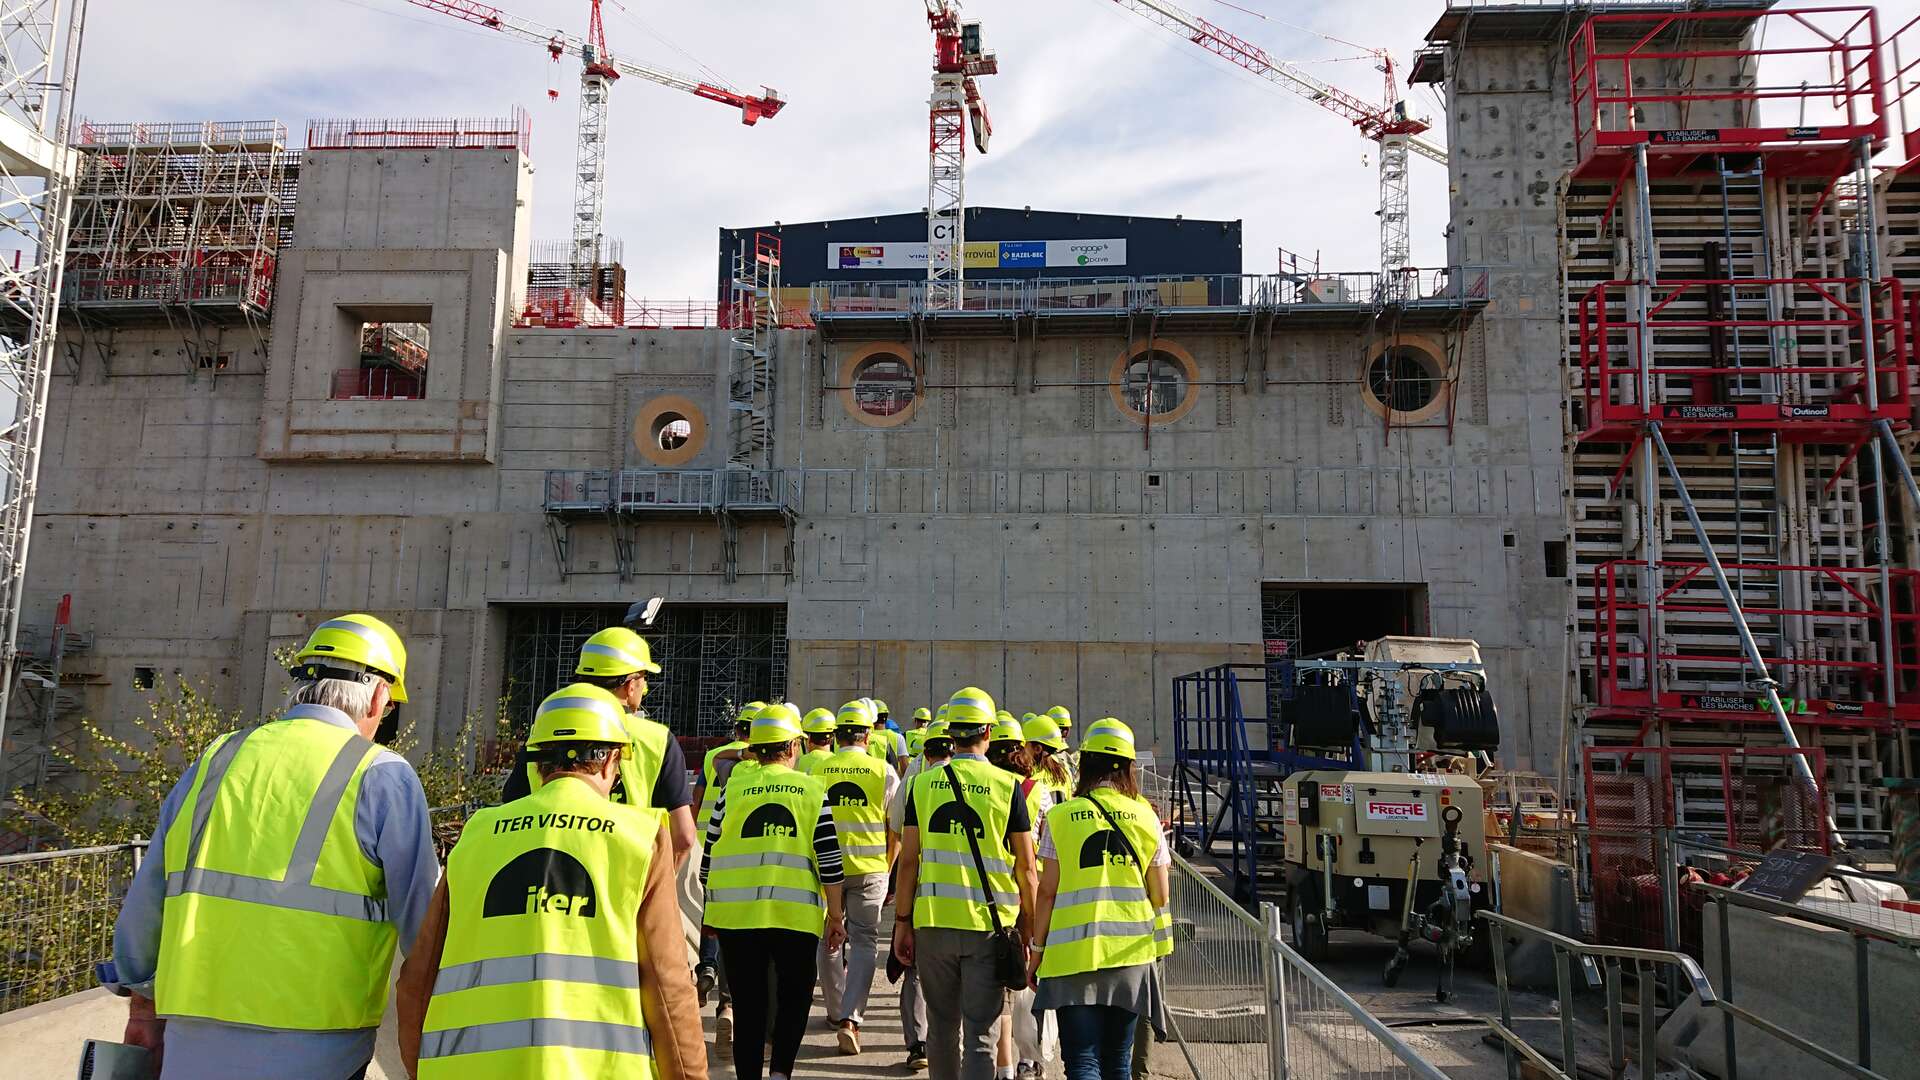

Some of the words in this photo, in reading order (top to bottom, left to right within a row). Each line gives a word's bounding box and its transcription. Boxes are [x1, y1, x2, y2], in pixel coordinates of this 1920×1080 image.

[934, 225, 955, 239] C1
[959, 249, 996, 259] rrovial
[840, 767, 871, 775] VISITOR
[743, 786, 763, 796] ITER
[765, 784, 804, 796] VISITOR
[931, 780, 951, 789] ITER
[952, 782, 991, 795] SITOR
[839, 795, 865, 807] iter
[1070, 810, 1094, 822] ITER
[1096, 810, 1137, 821] VITOR
[1369, 802, 1424, 816] FRECHE
[493, 815, 534, 835] ITER
[538, 813, 616, 834] VISITOR
[763, 822, 794, 838] iter
[950, 819, 981, 839] itr
[525, 885, 589, 917] iter
